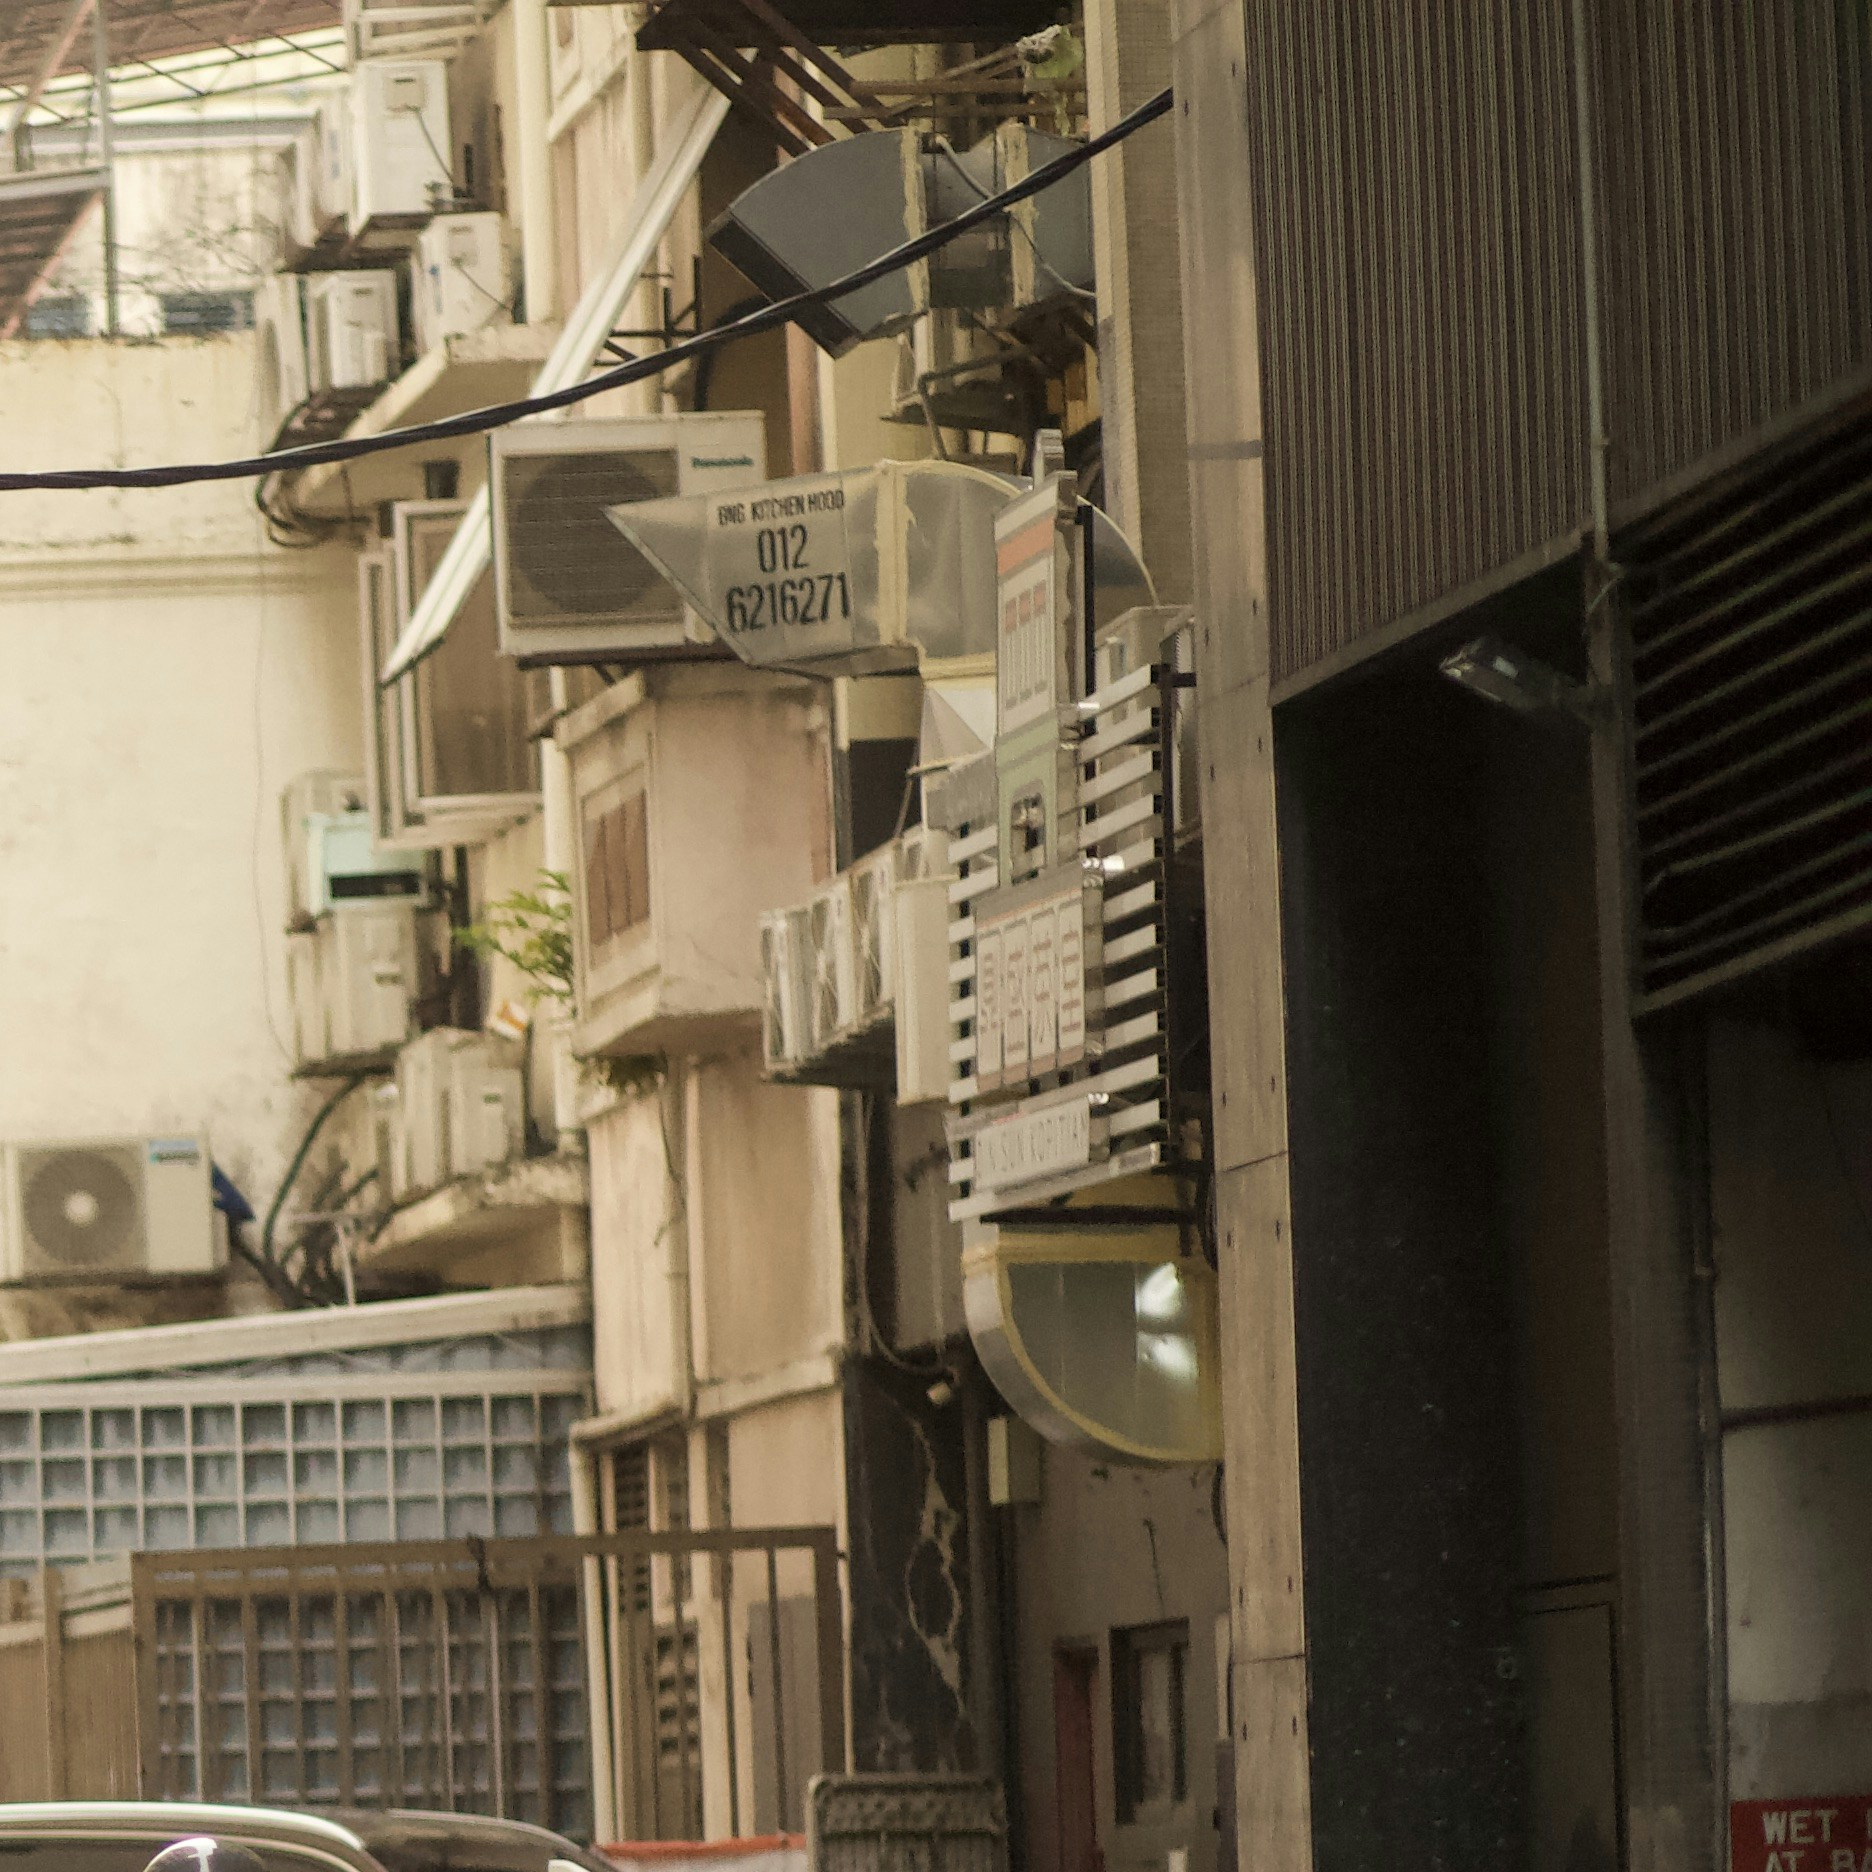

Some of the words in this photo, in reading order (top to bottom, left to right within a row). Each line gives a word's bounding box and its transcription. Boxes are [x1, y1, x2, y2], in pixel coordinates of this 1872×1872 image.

[750, 494, 805, 523] KITCHEN
[807, 488, 844, 515] HOOD
[757, 523, 810, 574] 012
[725, 571, 851, 636] 6216271
[1761, 1808, 1839, 1845] WET
